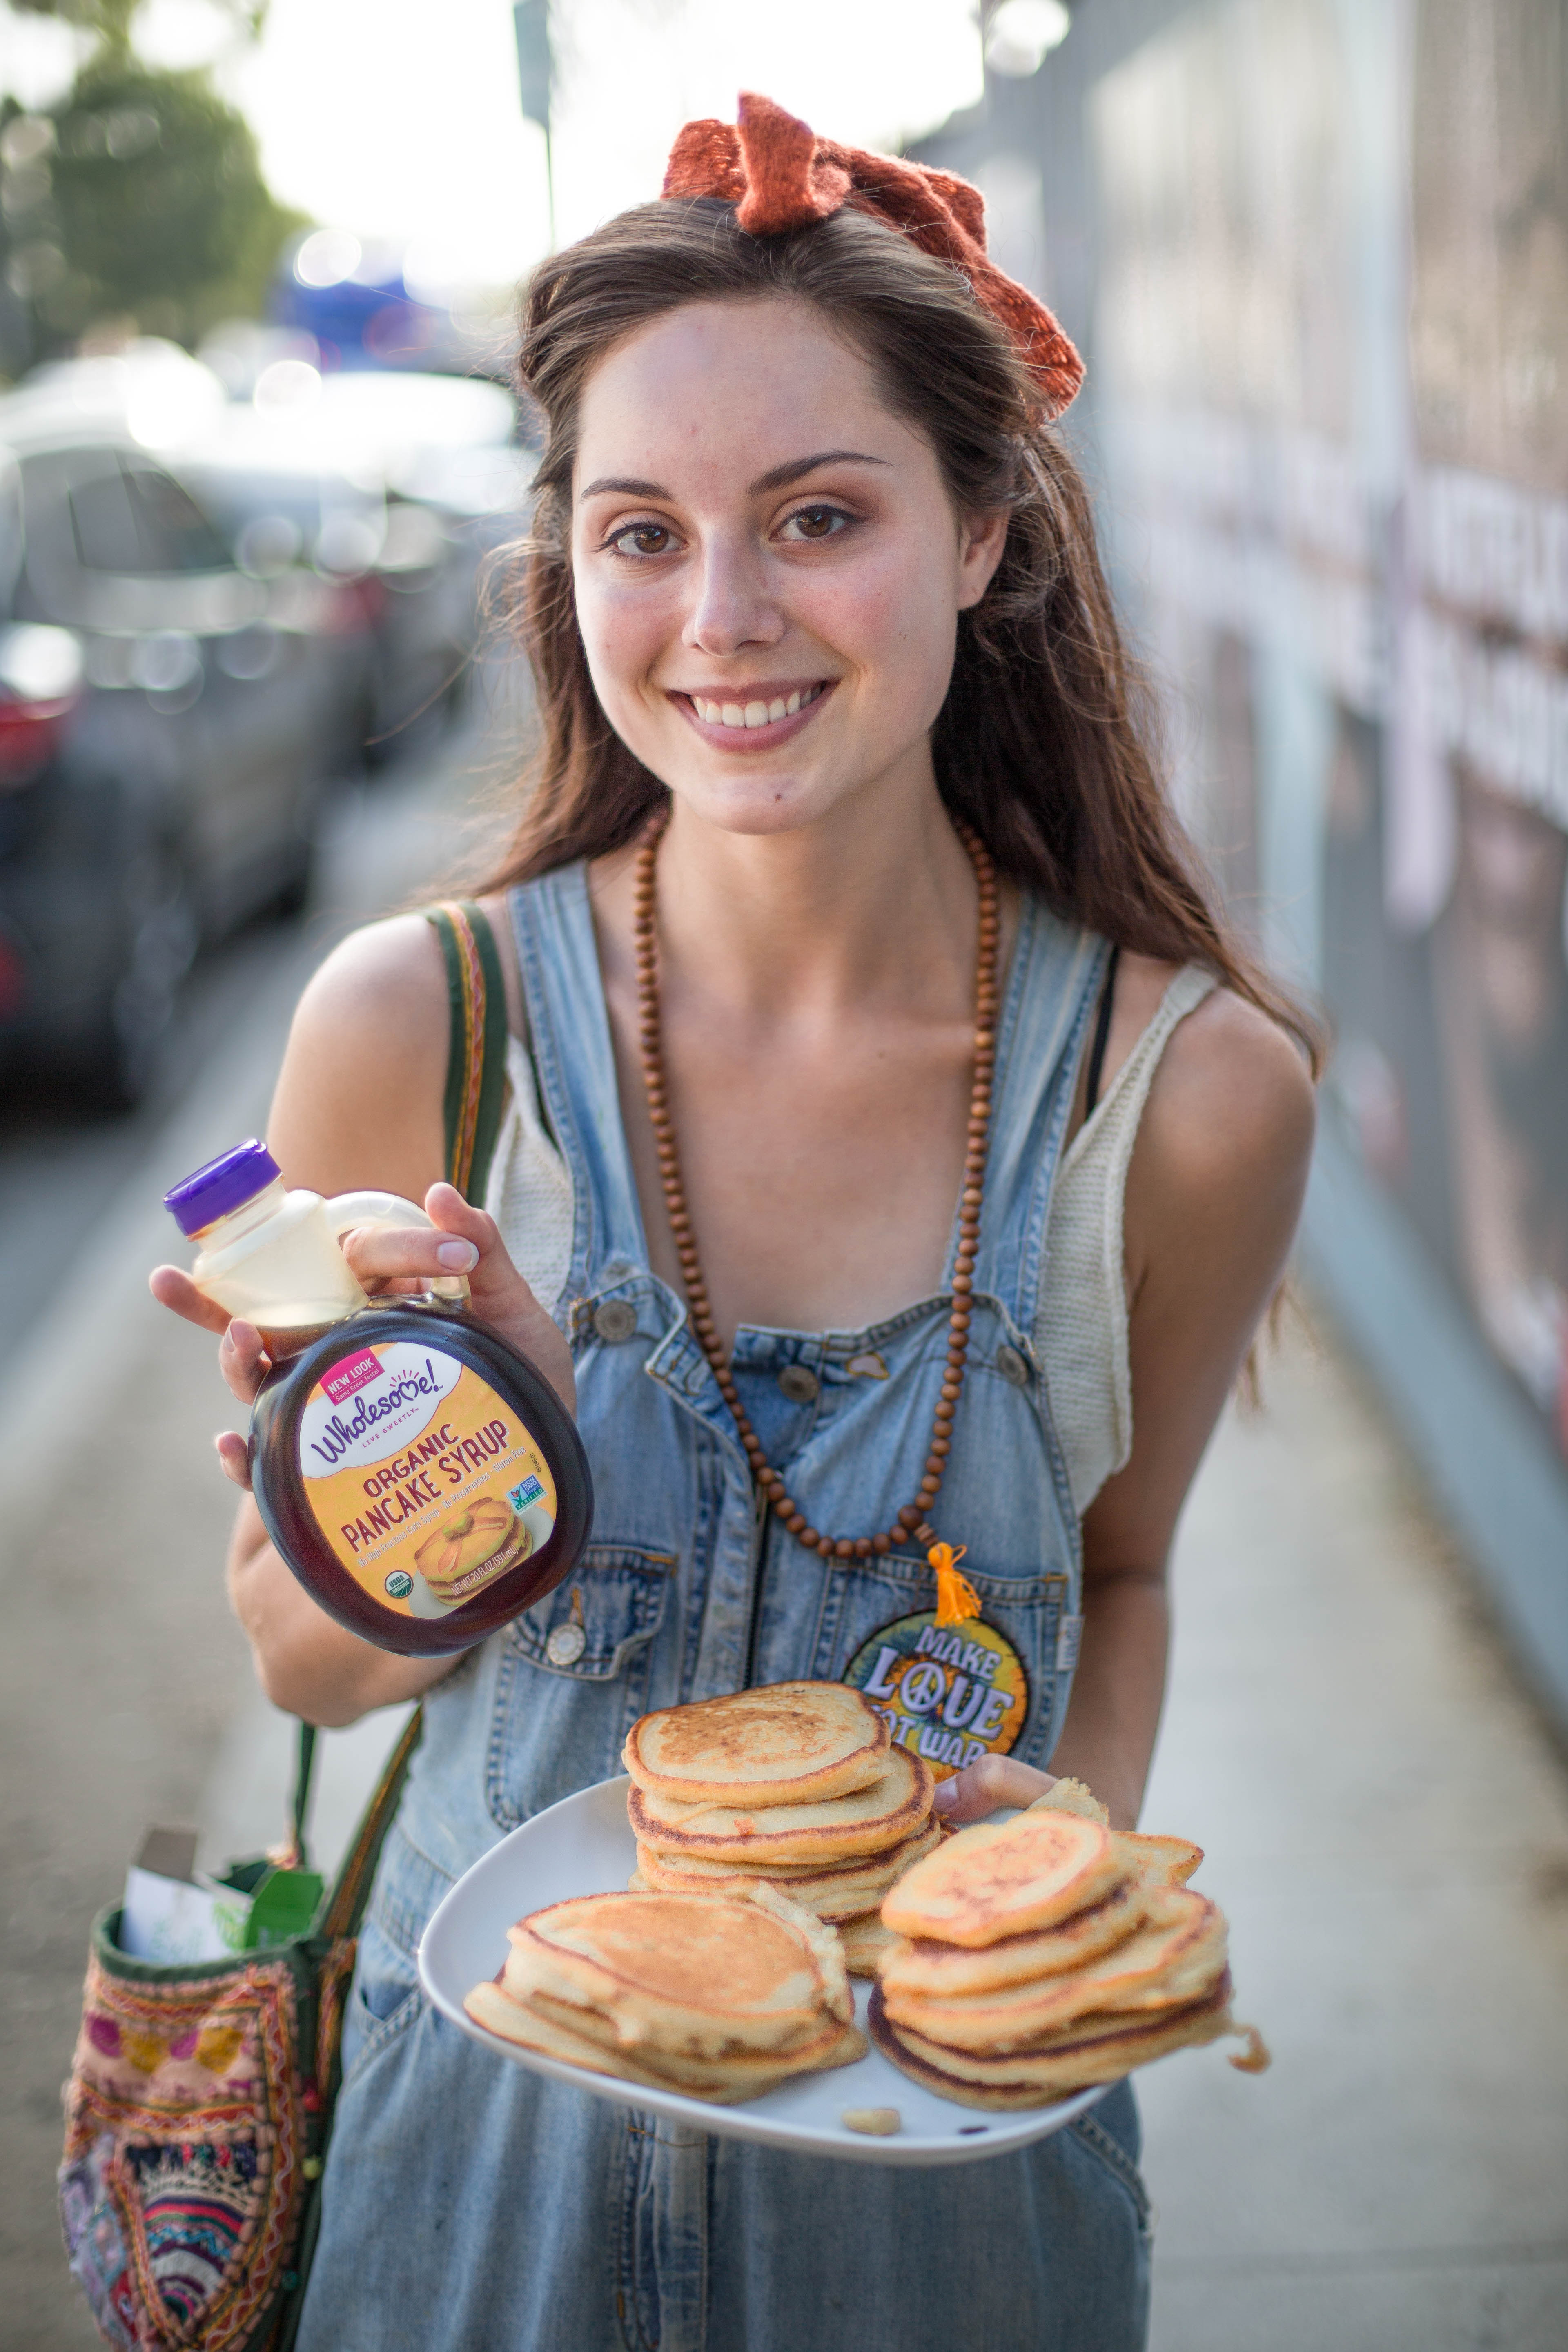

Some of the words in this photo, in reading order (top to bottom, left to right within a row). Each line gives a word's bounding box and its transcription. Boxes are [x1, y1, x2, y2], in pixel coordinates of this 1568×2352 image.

[327, 1373, 350, 1394] NEW
[352, 1357, 375, 1378] LOOK
[336, 1390, 350, 1401] Same
[350, 1380, 365, 1392] Great
[365, 1370, 379, 1381] Taste!
[362, 1434, 380, 1448] LIVE
[363, 1424, 459, 1498] ORGANIC
[341, 1470, 443, 1552] PANCAKE
[439, 1420, 508, 1483] SYRUP
[517, 1488, 543, 1508] VERIFIED
[522, 1477, 535, 1488] NON
[525, 1481, 537, 1491] GMO
[527, 1485, 539, 1494] Project
[357, 1558, 368, 1567] No
[366, 1548, 381, 1562] High
[380, 1531, 407, 1552] Fructose
[406, 1522, 422, 1534] Corn
[420, 1509, 440, 1524] Syrup
[441, 1499, 452, 1509] No
[451, 1472, 490, 1503] Preservatives
[493, 1456, 514, 1472] Gluten
[512, 1447, 526, 1459] Free
[389, 1575, 405, 1588] USDA
[392, 1580, 410, 1593] ORGANIC
[451, 1582, 464, 1596] NET
[461, 1576, 473, 1588] WT
[470, 1571, 481, 1582] 20
[506, 1544, 518, 1559] mL)
[914, 1625, 1001, 1682] MAKE
[864, 1647, 1014, 1741] LOVE
[919, 1726, 987, 1770] WAR
